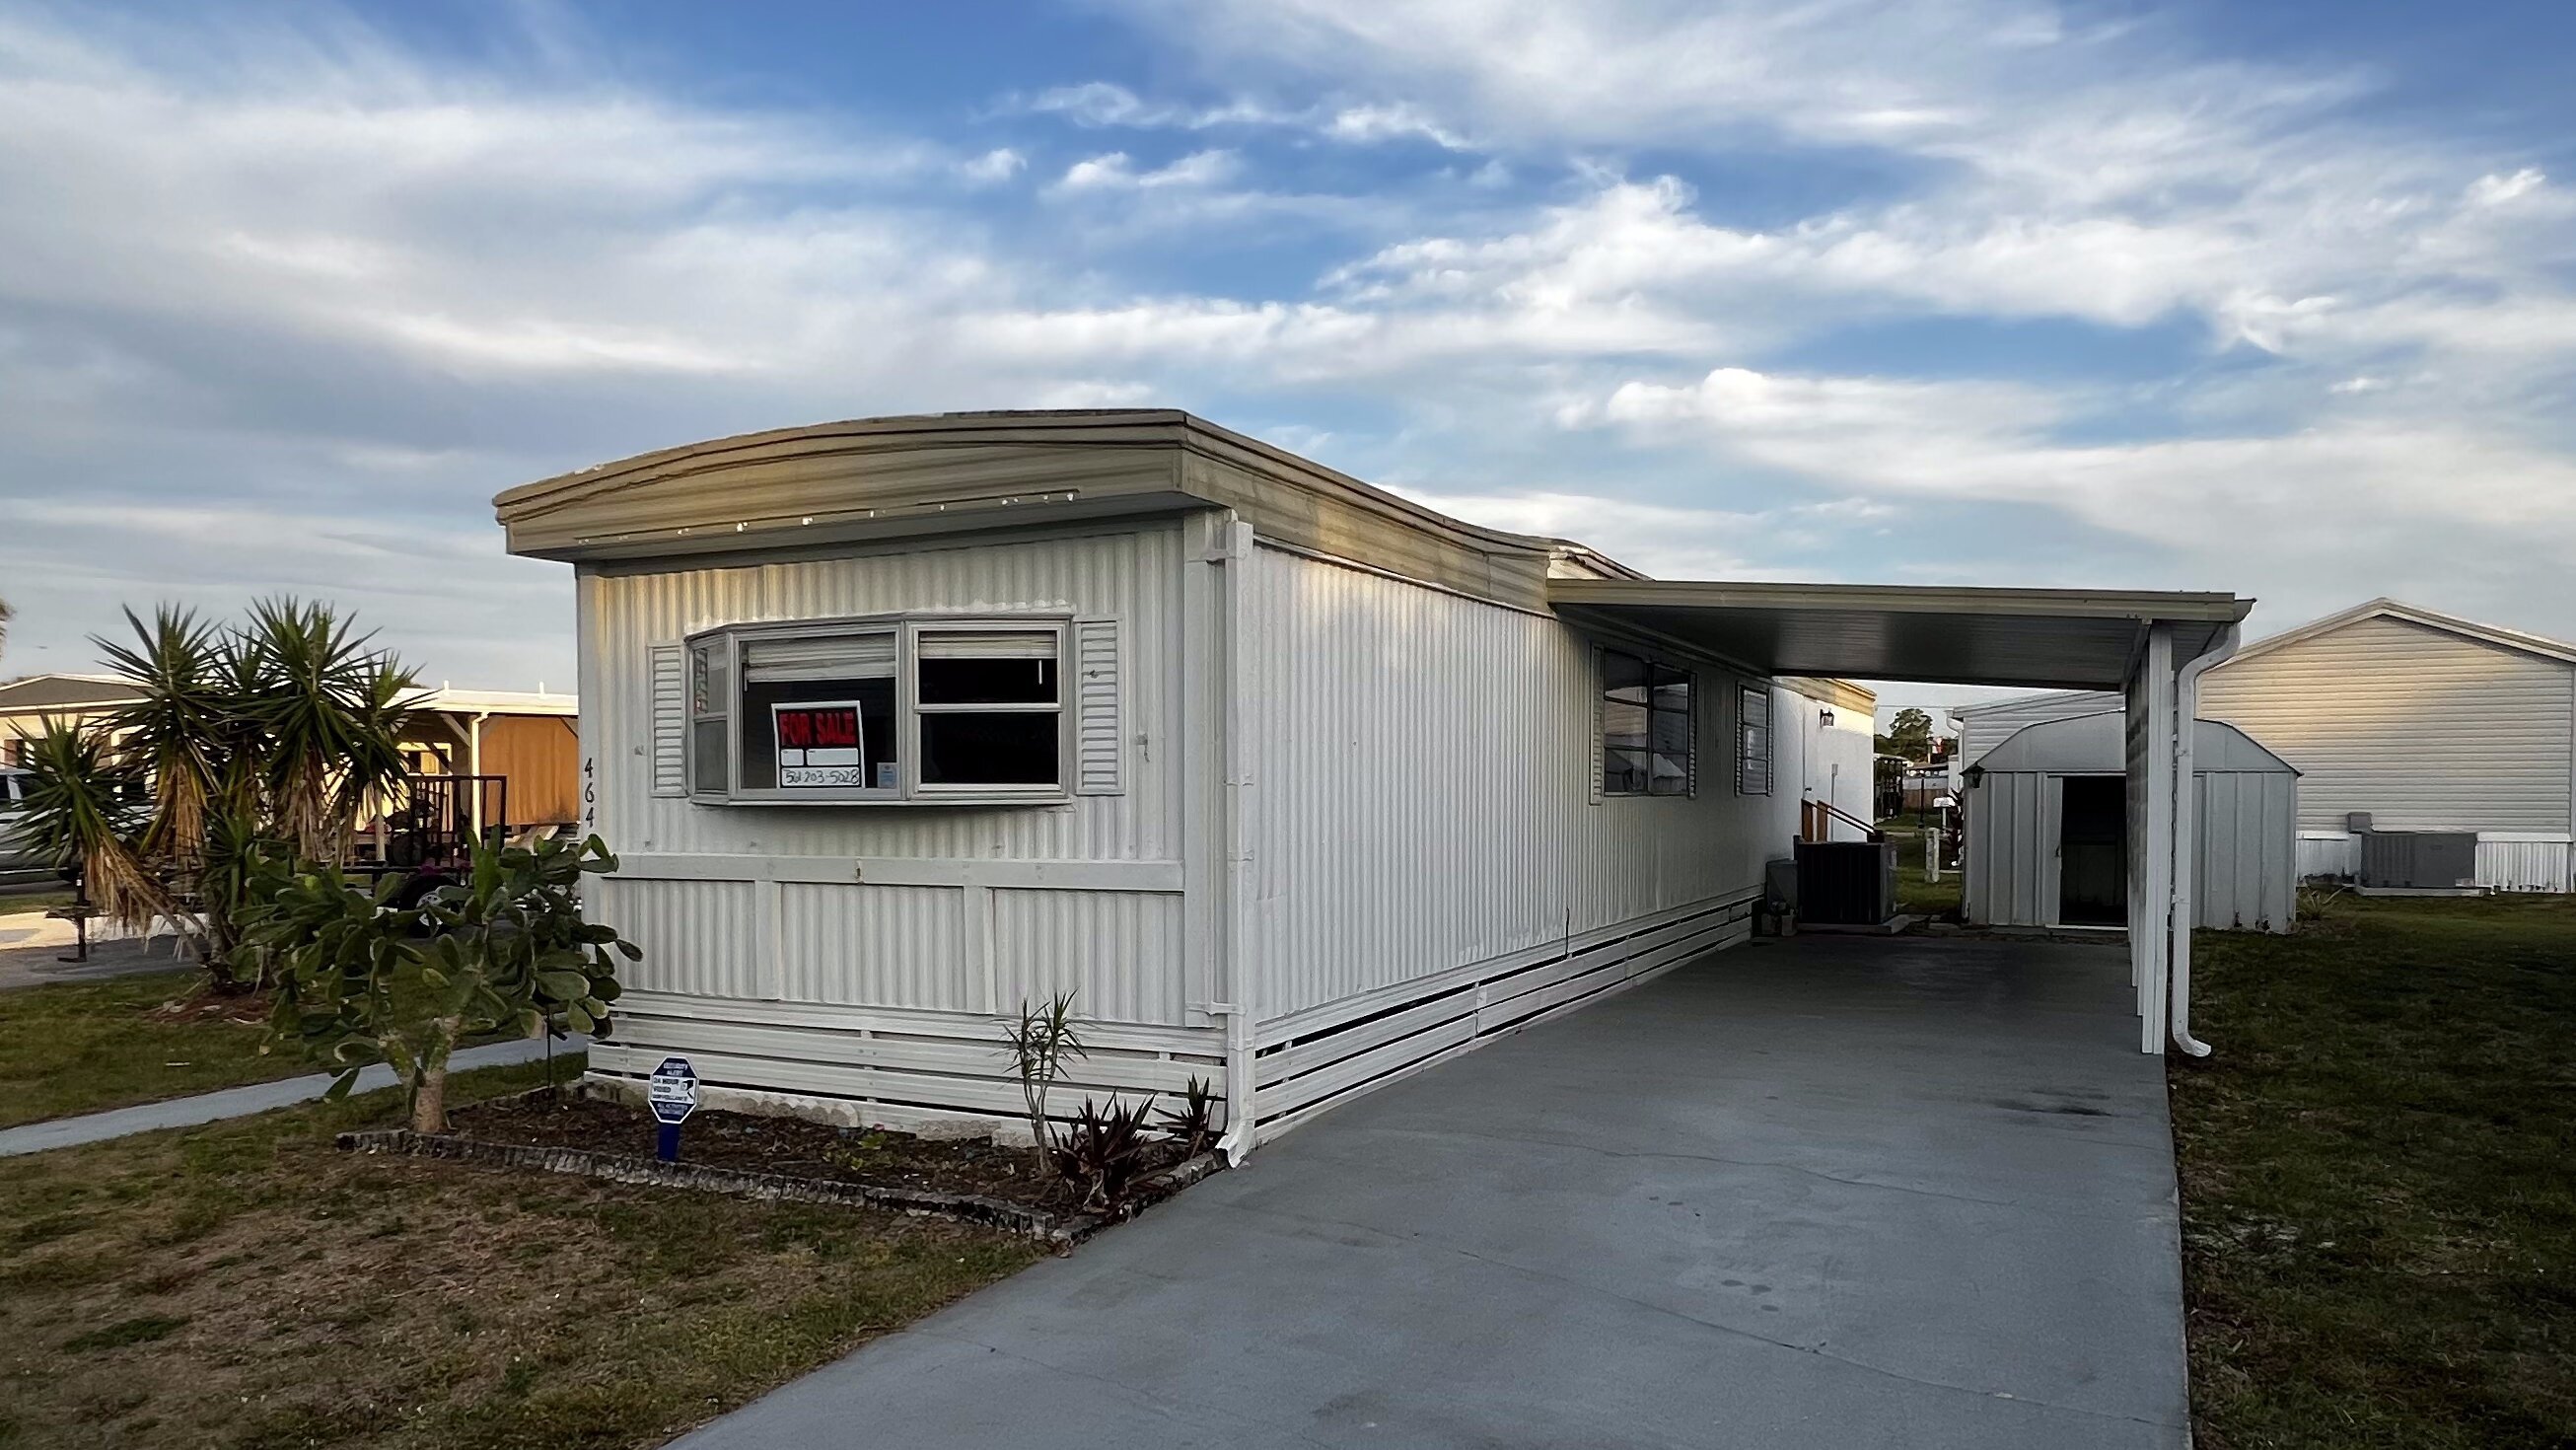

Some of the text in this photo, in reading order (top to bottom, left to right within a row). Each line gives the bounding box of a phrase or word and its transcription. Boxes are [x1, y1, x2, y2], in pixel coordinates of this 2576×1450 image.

[779, 712, 855, 745] FOR SALE
[585, 758, 595, 828] 464
